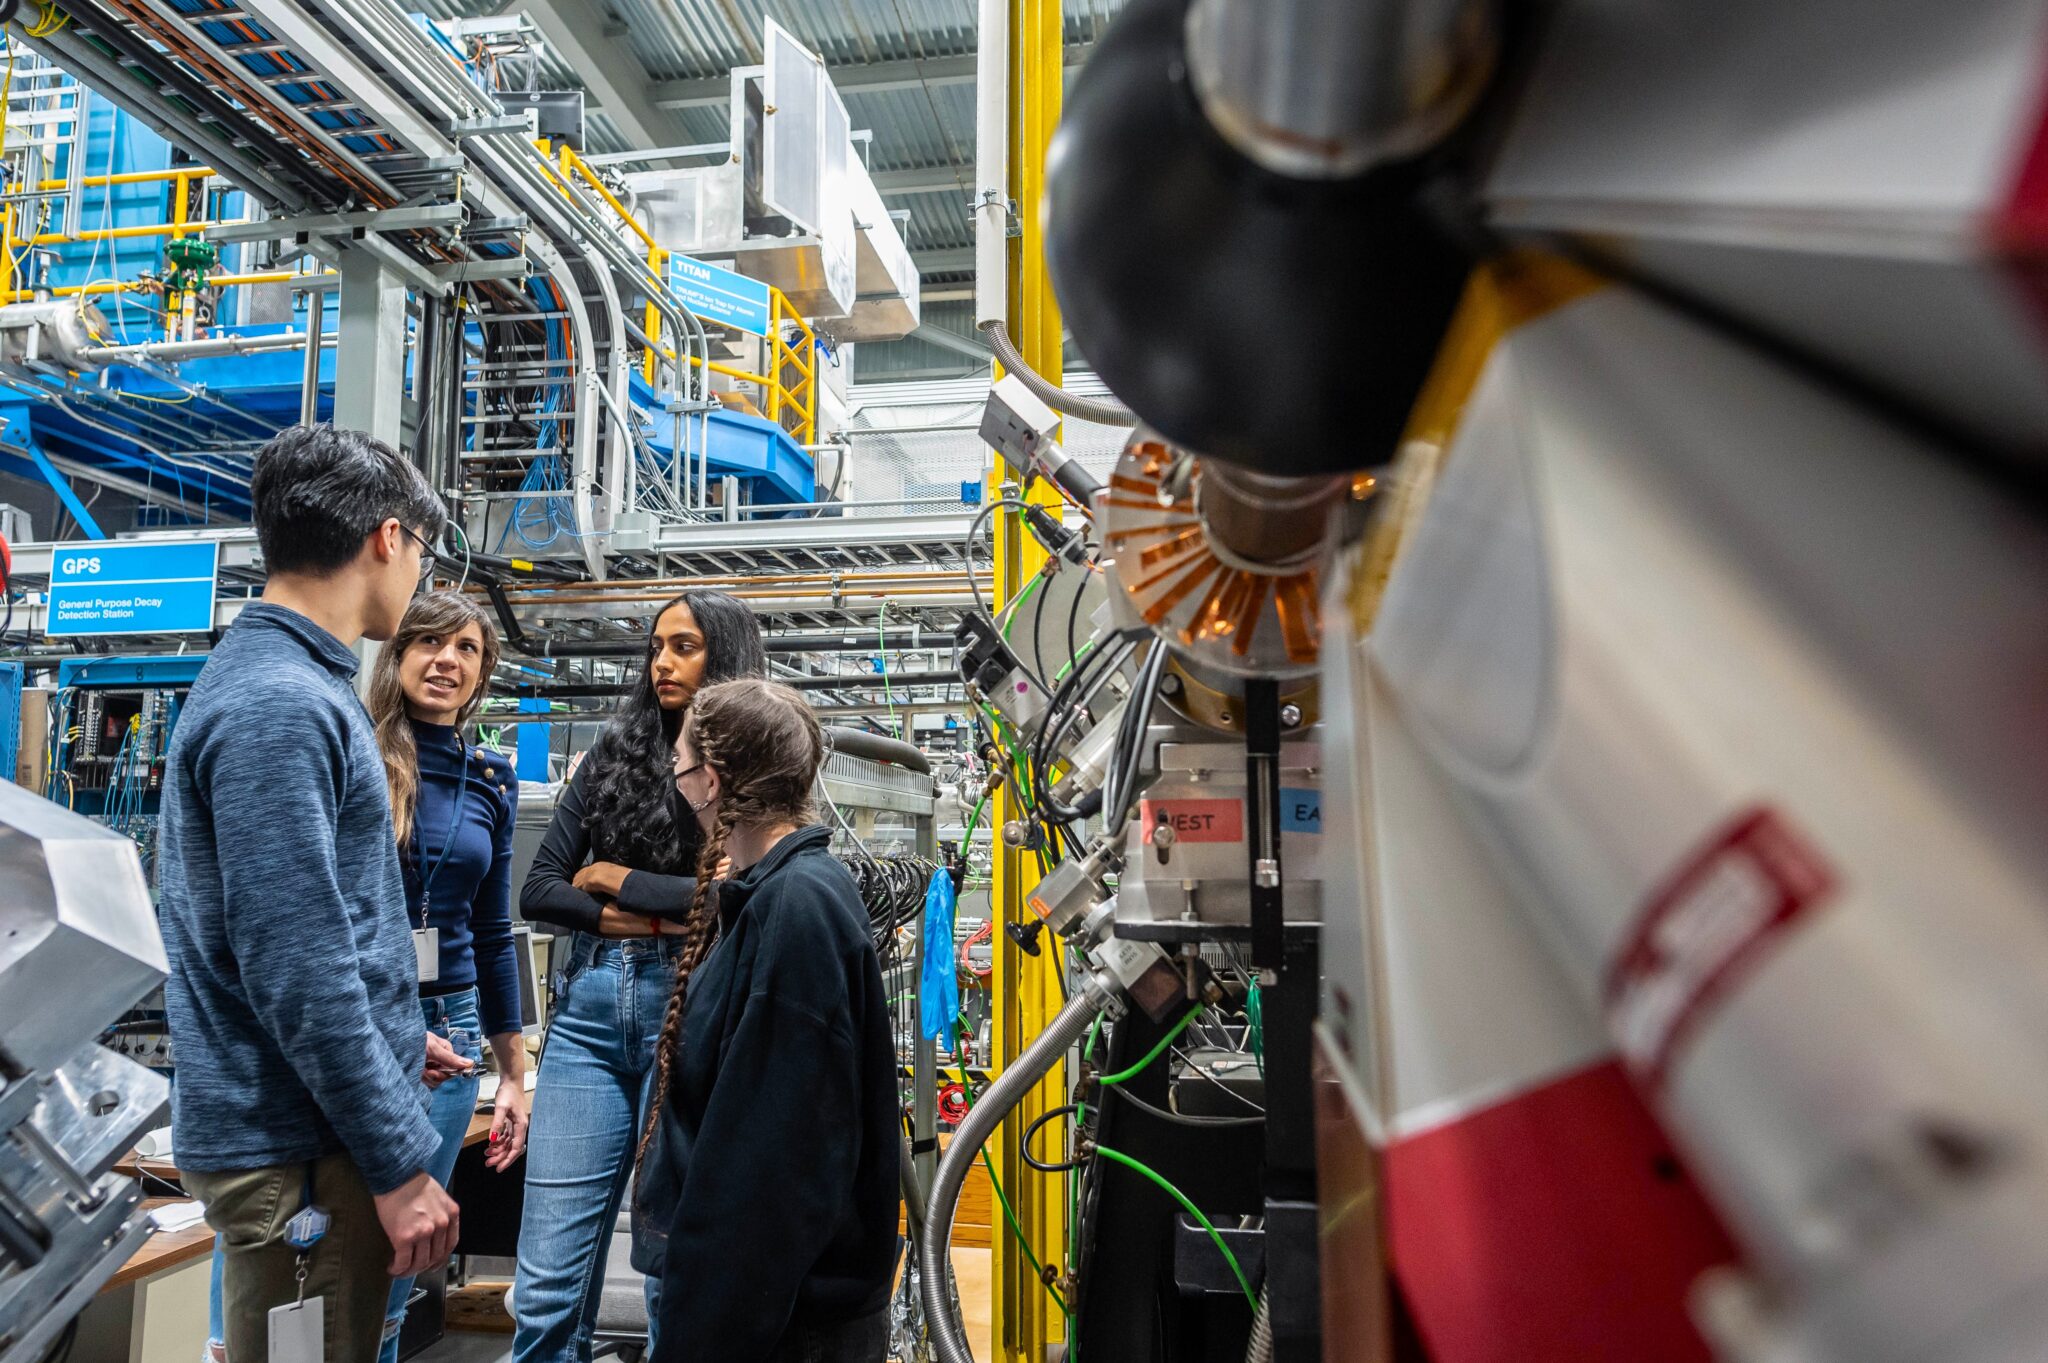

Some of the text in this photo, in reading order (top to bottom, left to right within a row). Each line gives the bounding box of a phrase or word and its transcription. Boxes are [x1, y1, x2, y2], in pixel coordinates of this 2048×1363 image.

[676, 260, 710, 281] TITAN
[62, 557, 101, 575] GPS
[58, 597, 163, 610] General Purpose Decay
[58, 609, 134, 620] Detection Station
[1172, 814, 1215, 831] EST
